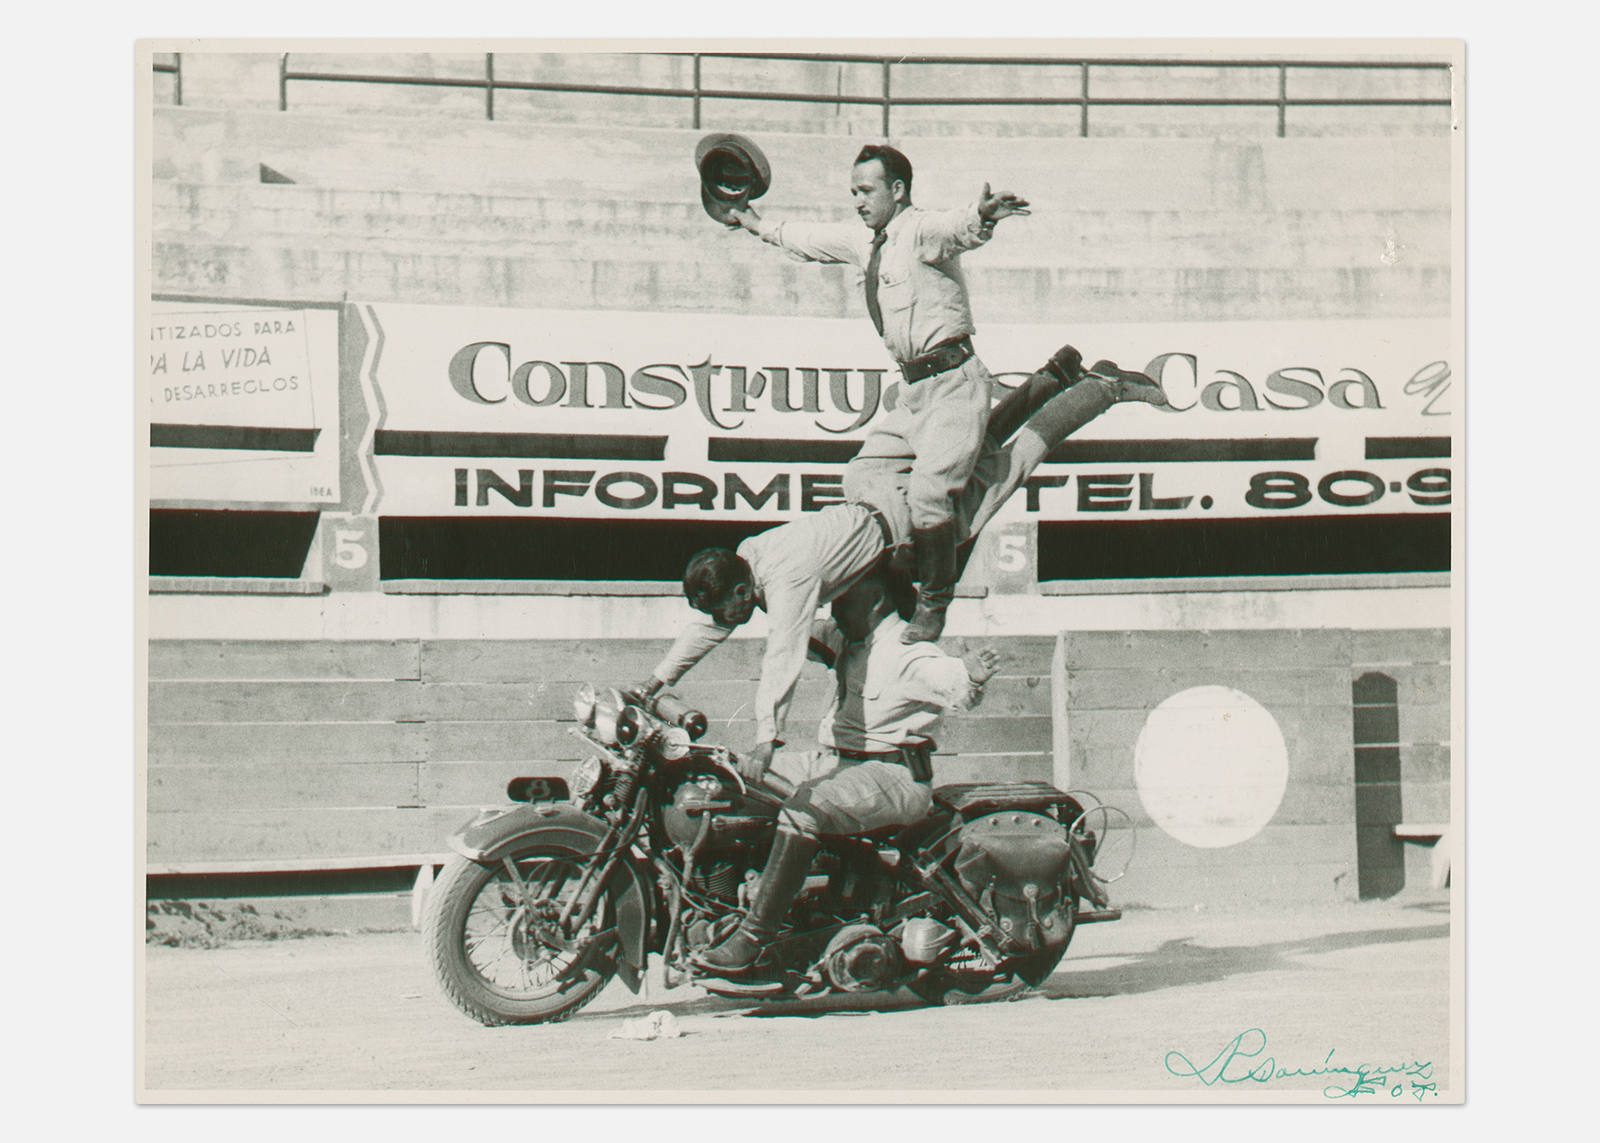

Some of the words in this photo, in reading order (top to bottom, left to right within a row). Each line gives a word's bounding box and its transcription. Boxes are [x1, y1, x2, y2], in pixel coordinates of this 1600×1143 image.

[150, 321, 242, 341] TIZADOS
[254, 320, 296, 335] PARA
[182, 350, 206, 372] LA
[221, 346, 272, 368] VIDA
[164, 375, 299, 403] DESARREGLOS
[1143, 352, 1387, 413] Casa
[1020, 473, 1214, 512] TEL.
[335, 530, 368, 569] 5
[997, 535, 1027, 572] 5
